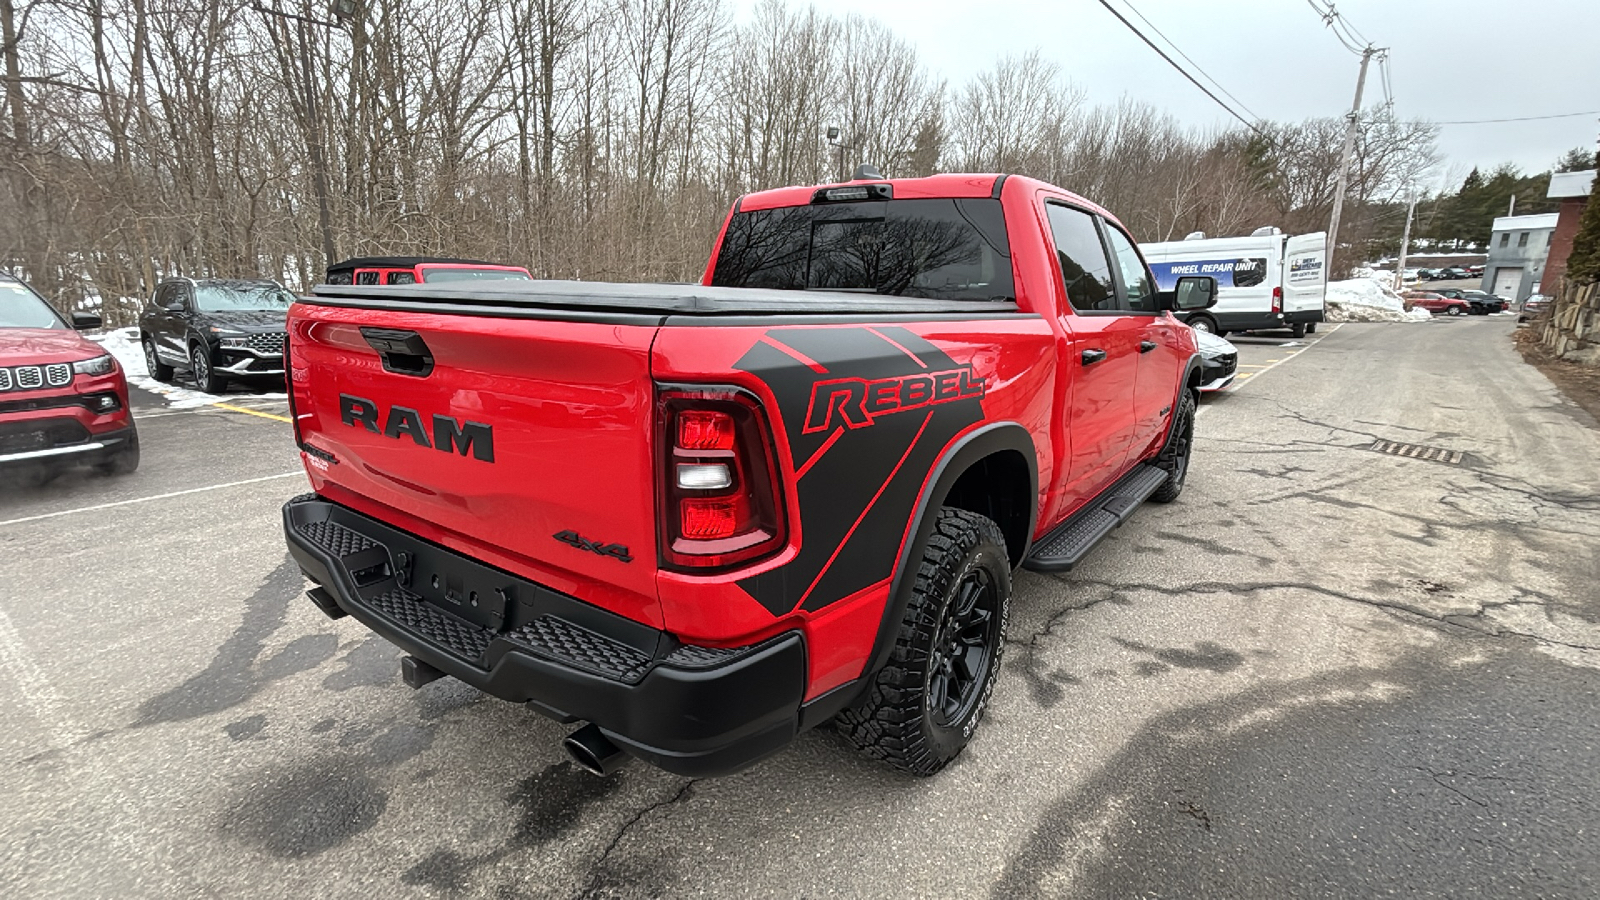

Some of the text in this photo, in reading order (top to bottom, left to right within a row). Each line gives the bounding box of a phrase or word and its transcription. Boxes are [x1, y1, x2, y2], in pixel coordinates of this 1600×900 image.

[1170, 261, 1258, 274] WHEEL REPAIR UNIT
[339, 392, 495, 463] RAM
[802, 364, 985, 434] REBEL
